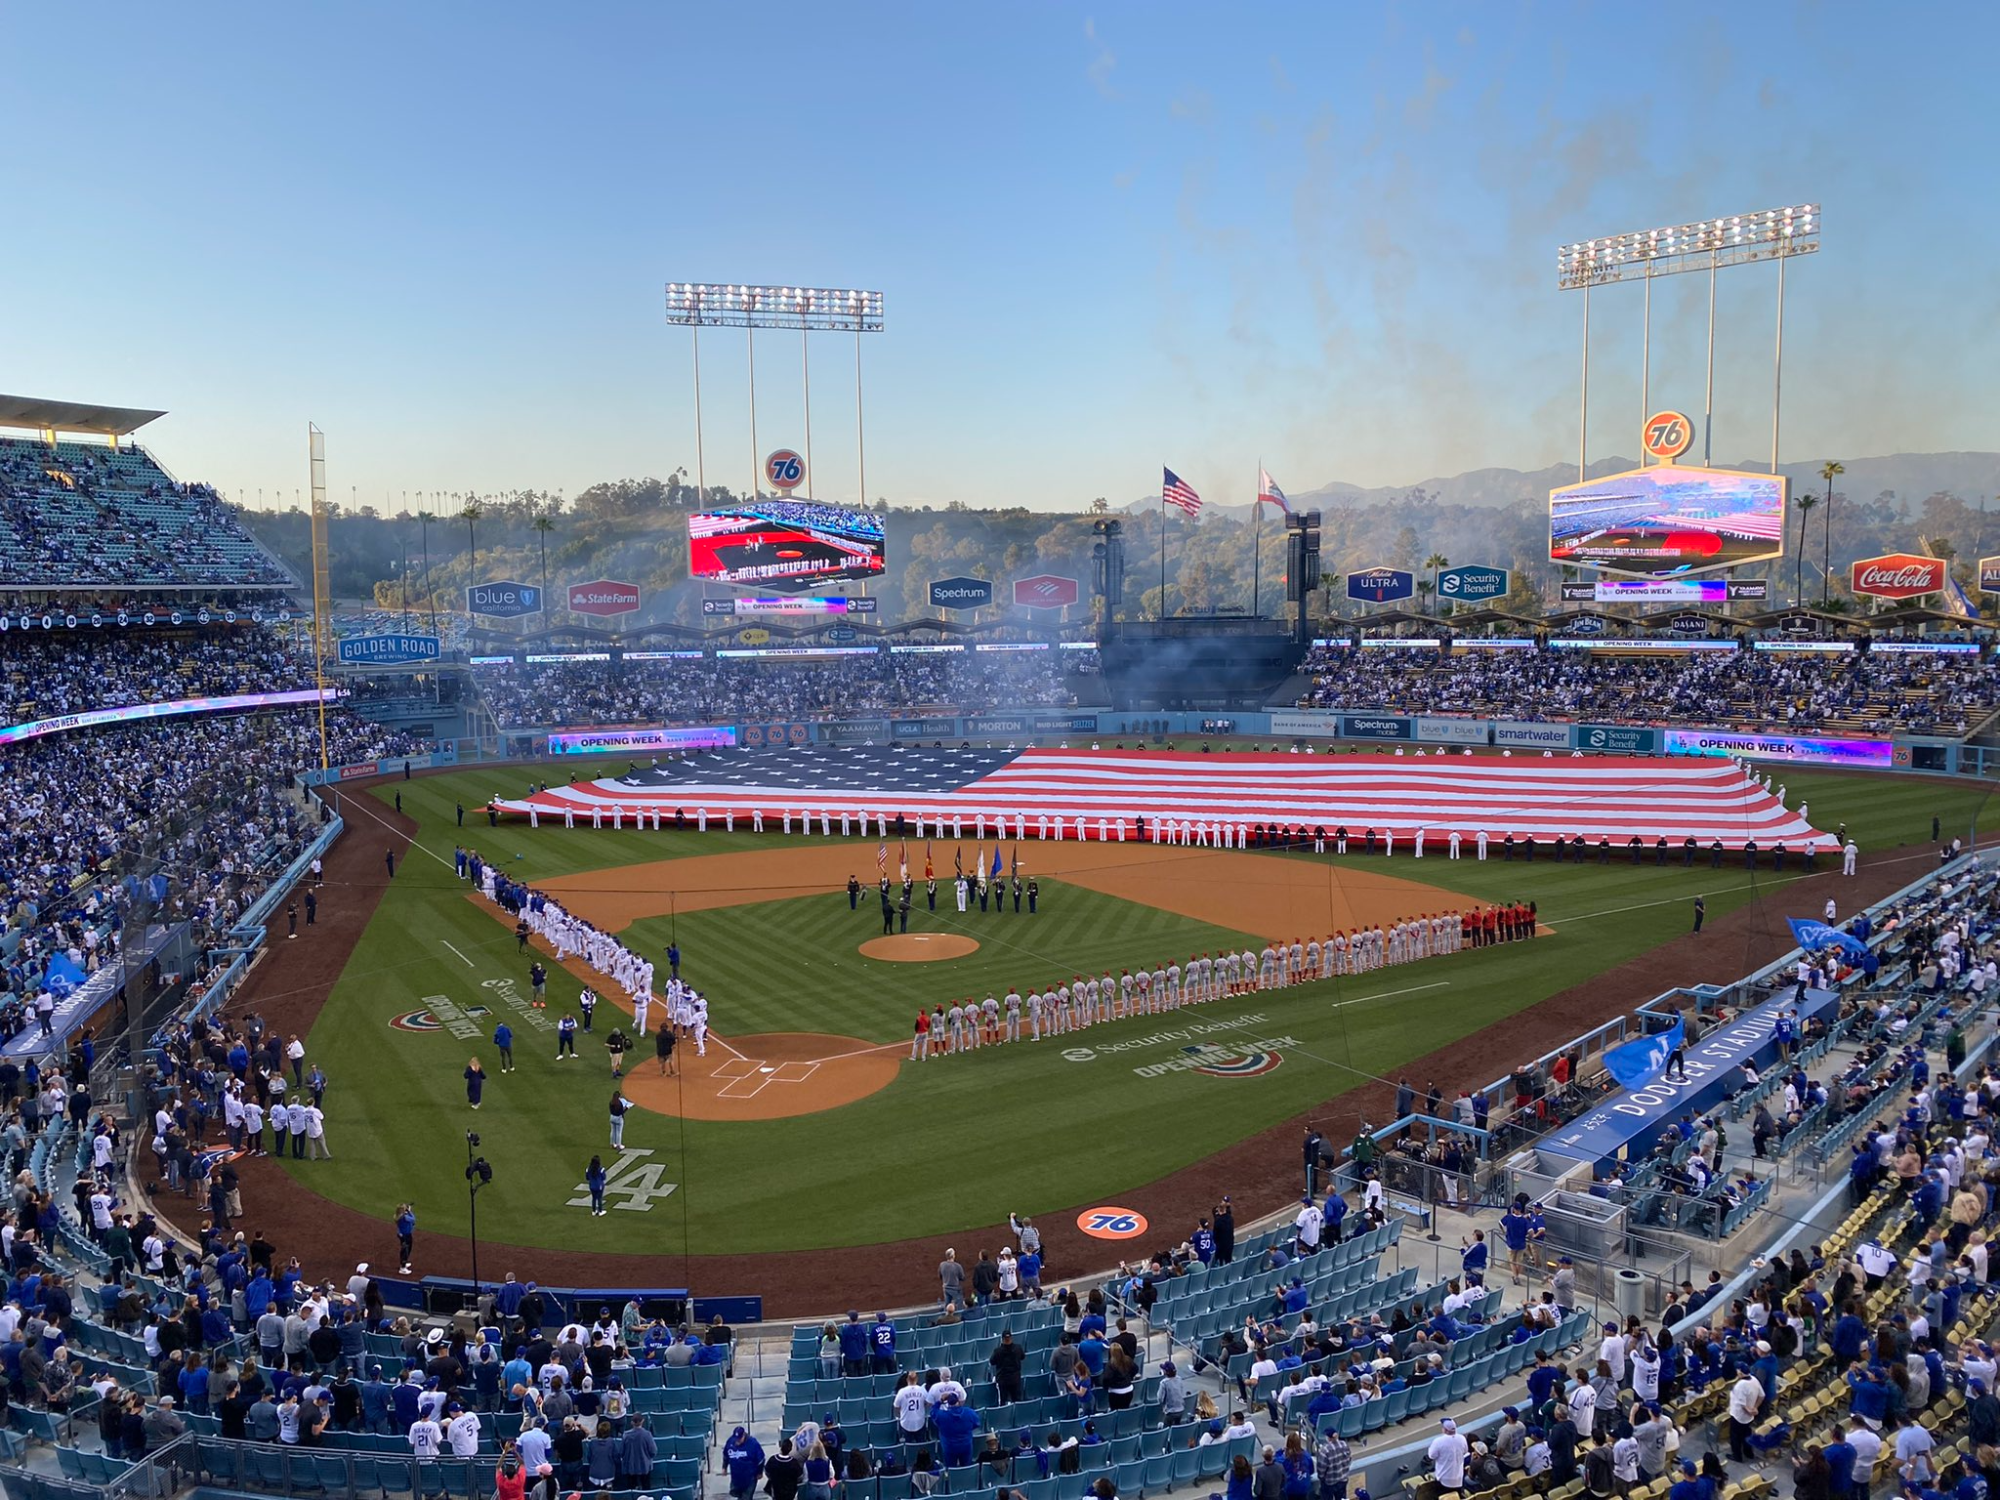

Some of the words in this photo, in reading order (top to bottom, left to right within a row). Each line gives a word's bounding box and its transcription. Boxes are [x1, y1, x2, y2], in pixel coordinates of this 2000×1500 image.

[1649, 420, 1684, 449] 76
[770, 456, 801, 481] 76
[1464, 573, 1500, 584] Security
[1860, 565, 1935, 588] Coca-Cola
[1361, 578, 1399, 588] ULTRA
[1464, 584, 1496, 593] Benefit
[475, 589, 516, 604] blue
[934, 588, 984, 599] Spectrum
[481, 604, 521, 612] california
[199, 613, 208, 621] 42
[1674, 621, 1704, 629] DASANI
[344, 638, 396, 658] GOLDEN
[401, 639, 436, 655] ROAD
[36, 719, 60, 732] OPENING
[60, 716, 79, 727] WEEK
[922, 724, 950, 732] Health
[978, 722, 1021, 731] MORTON
[1354, 720, 1399, 730] Spectrum
[792, 730, 804, 738] 76
[1455, 726, 1474, 734] blue
[1499, 729, 1566, 742] smartwater
[581, 737, 629, 747] OPENING
[632, 736, 662, 744] WEEK
[750, 732, 760, 740] 76
[1608, 730, 1641, 742] Security
[1608, 740, 1637, 749] Benefit
[1700, 739, 1755, 751] OPENING
[1757, 743, 1795, 754] WEEK
[1894, 750, 1908, 760] 76
[1096, 1029, 1192, 1054] Security
[1189, 1013, 1270, 1034] Benefit
[1133, 1050, 1240, 1078] OPENING
[1234, 1035, 1304, 1056] WEEK
[1612, 1059, 1717, 1117] DODGER
[1702, 1009, 1789, 1059] STADIUM
[565, 1148, 679, 1212] LA
[93, 1201, 103, 1210] 20
[1086, 1214, 1140, 1233] 76
[1200, 1240, 1210, 1250] 50
[1872, 1248, 1882, 1258] 10
[878, 1332, 890, 1344] 22
[908, 1400, 920, 1411] 21
[282, 1416, 290, 1427] 2
[466, 1425, 474, 1437] 5
[418, 1435, 428, 1447] 21
